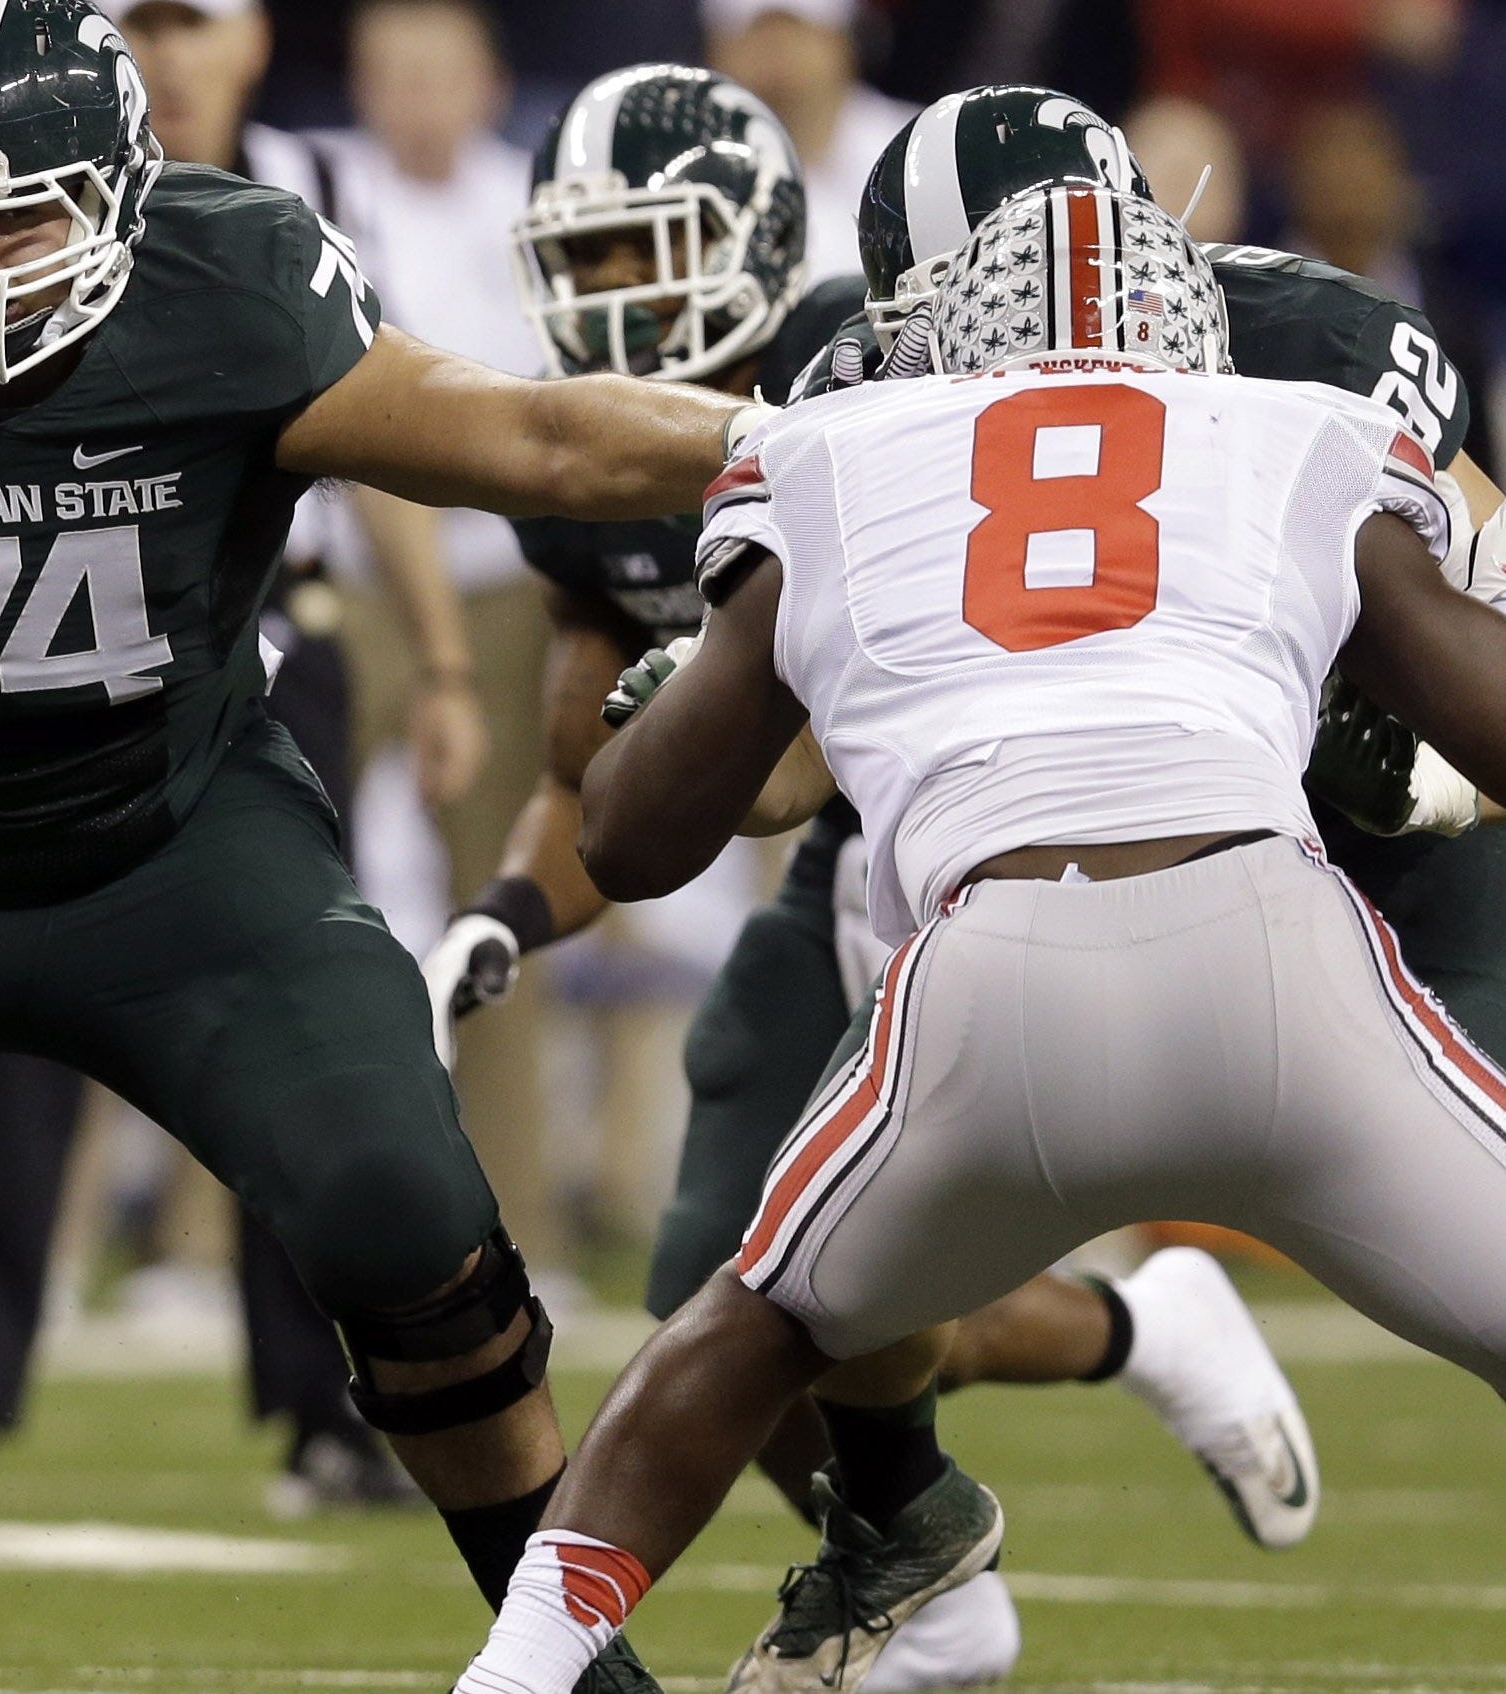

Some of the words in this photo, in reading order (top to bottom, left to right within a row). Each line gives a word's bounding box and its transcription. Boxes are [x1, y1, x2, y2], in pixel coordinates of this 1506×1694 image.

[1137, 321, 1150, 342] 8
[54, 471, 184, 520] STATE
[961, 382, 1167, 653] 8
